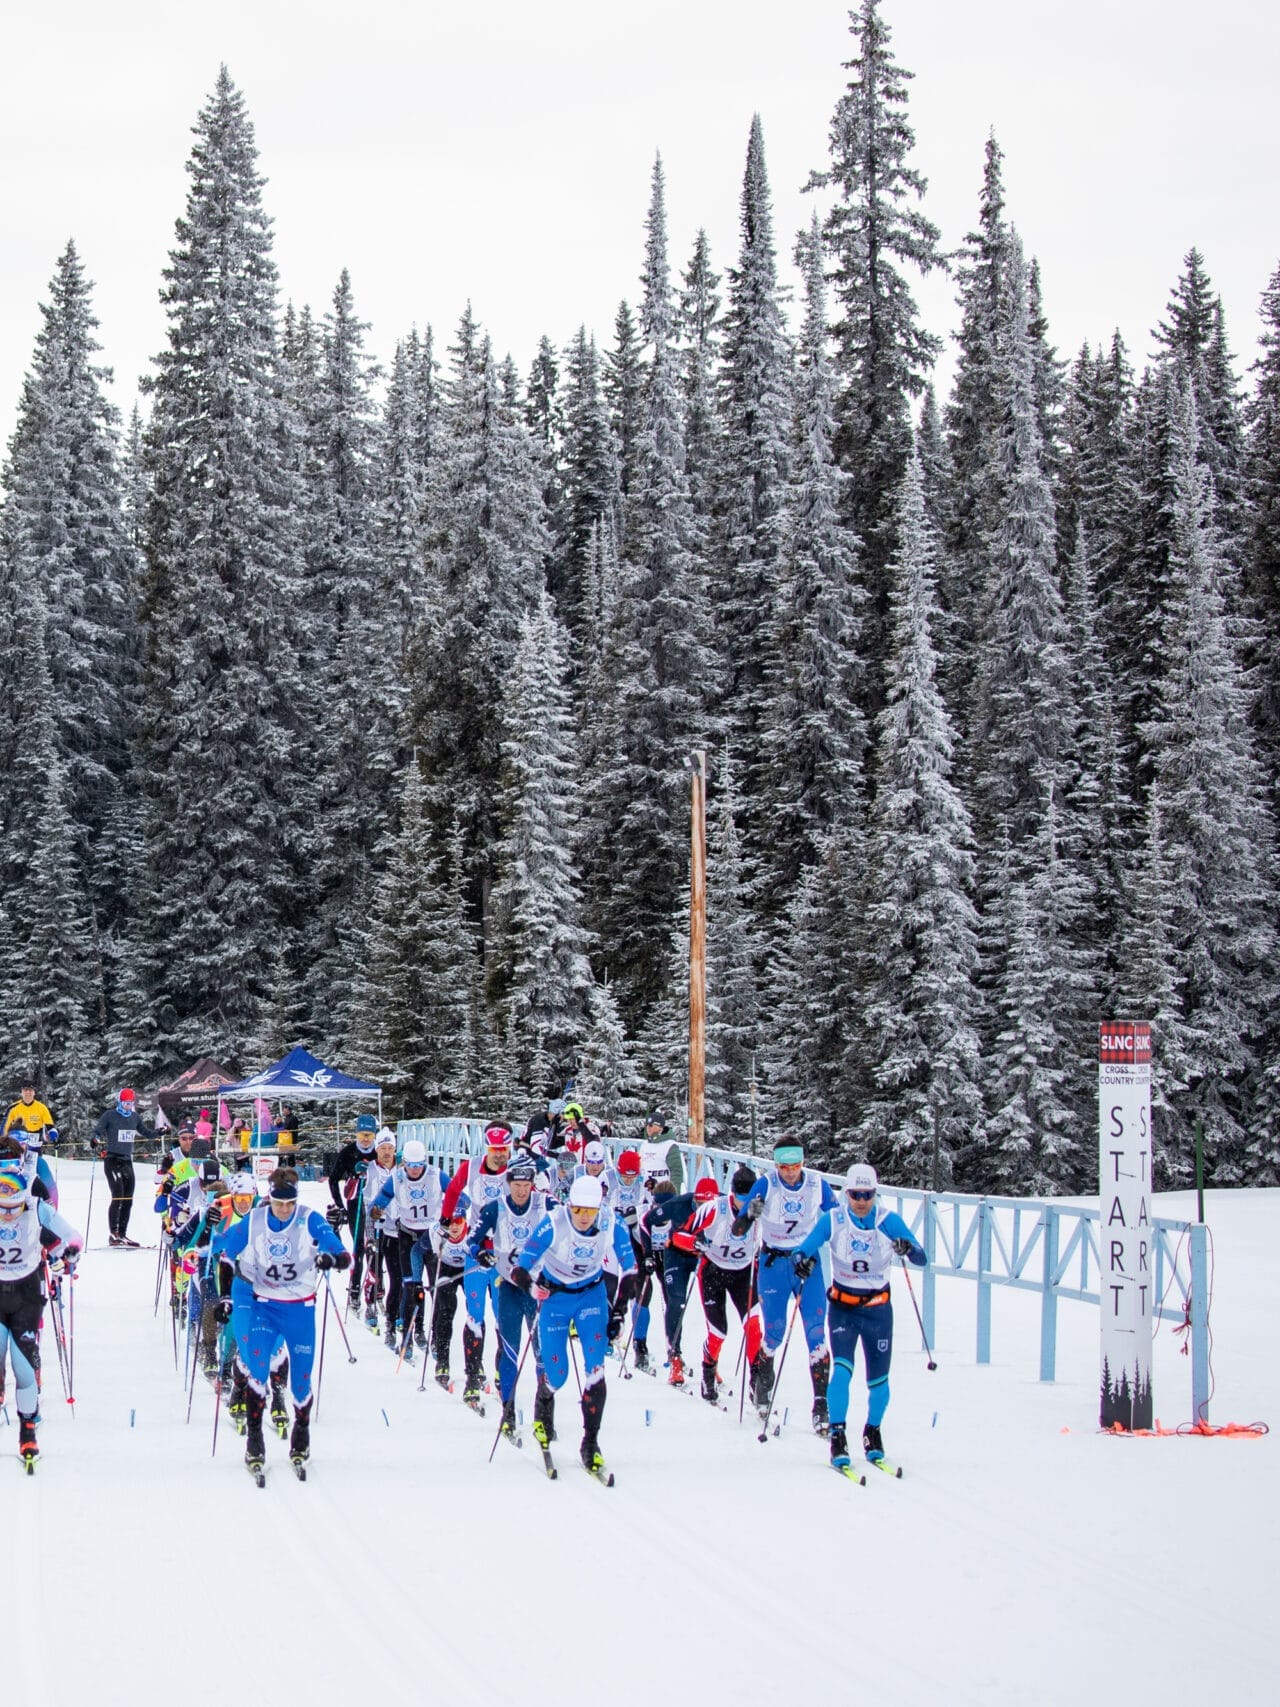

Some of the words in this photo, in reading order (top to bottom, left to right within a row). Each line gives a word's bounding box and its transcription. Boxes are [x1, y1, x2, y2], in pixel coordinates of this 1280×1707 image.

[1101, 1035, 1133, 1050] SLNC
[1100, 1077, 1134, 1085] COUNTRY
[410, 1205, 428, 1218] 11
[1108, 1106, 1126, 1316] START
[1138, 1106, 1148, 1316] START
[784, 1221, 799, 1233] 7
[720, 1246, 747, 1259] 16
[265, 1263, 298, 1281] 43
[572, 1265, 588, 1275] 5
[852, 1260, 869, 1273] 8
